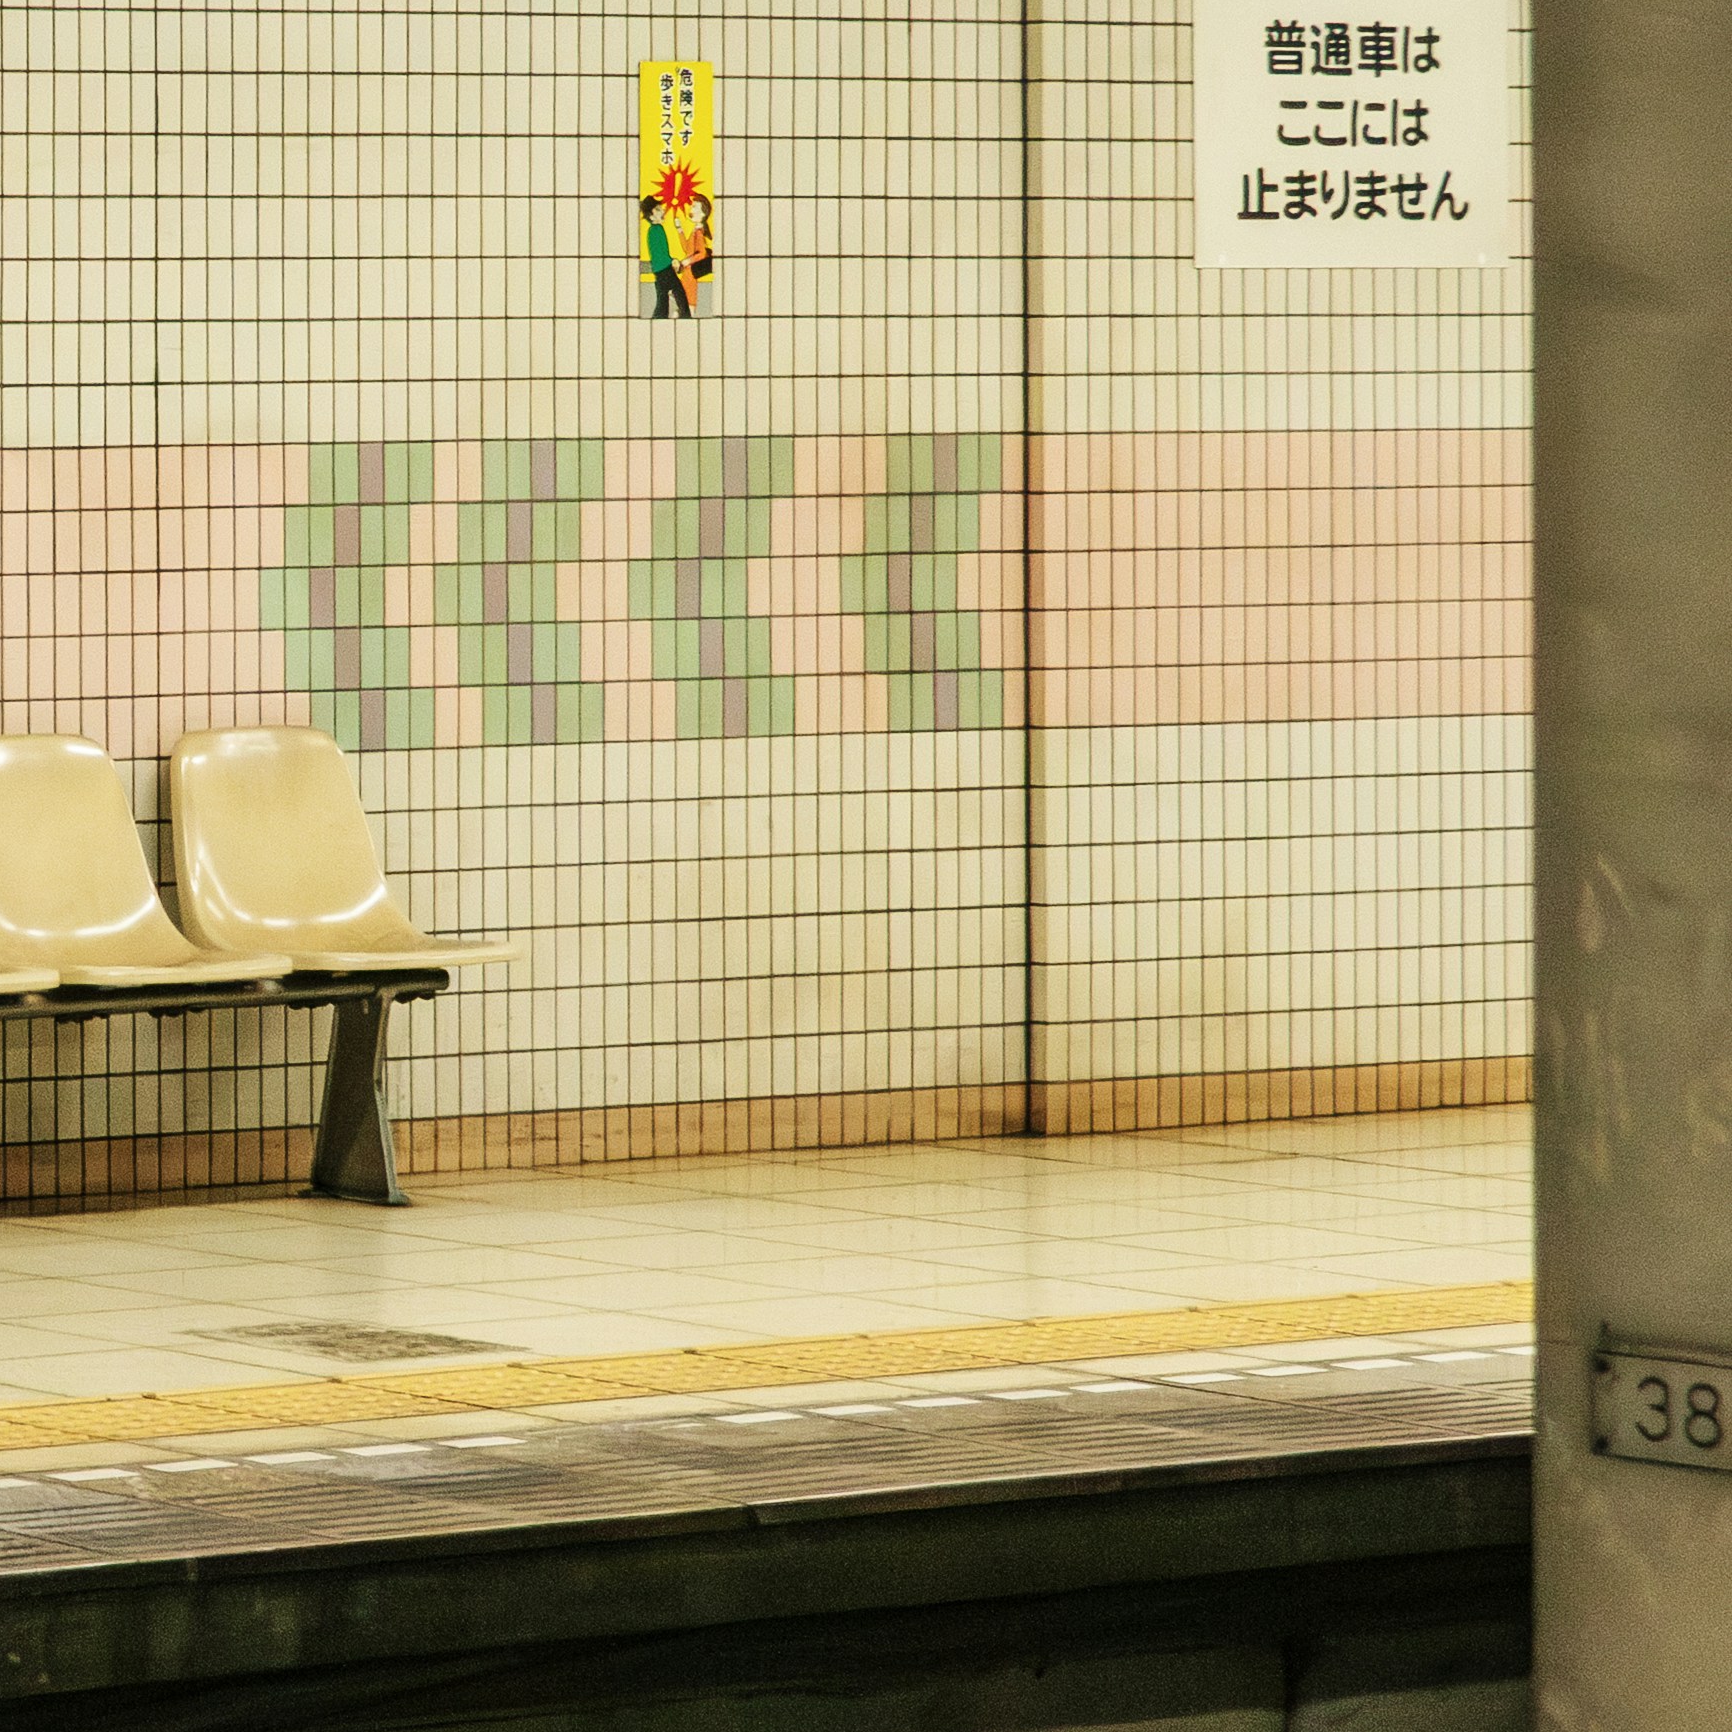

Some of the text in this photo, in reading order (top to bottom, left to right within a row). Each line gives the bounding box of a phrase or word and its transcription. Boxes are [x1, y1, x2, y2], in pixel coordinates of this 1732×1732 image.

[1265, 19, 1440, 77] 普通車は
[660, 73, 674, 165] 歩きスマホ
[679, 68, 694, 146] 危険です
[1277, 98, 1429, 147] ここには
[1237, 167, 1469, 221] 止まりません
[1635, 1375, 1723, 1449] 38
